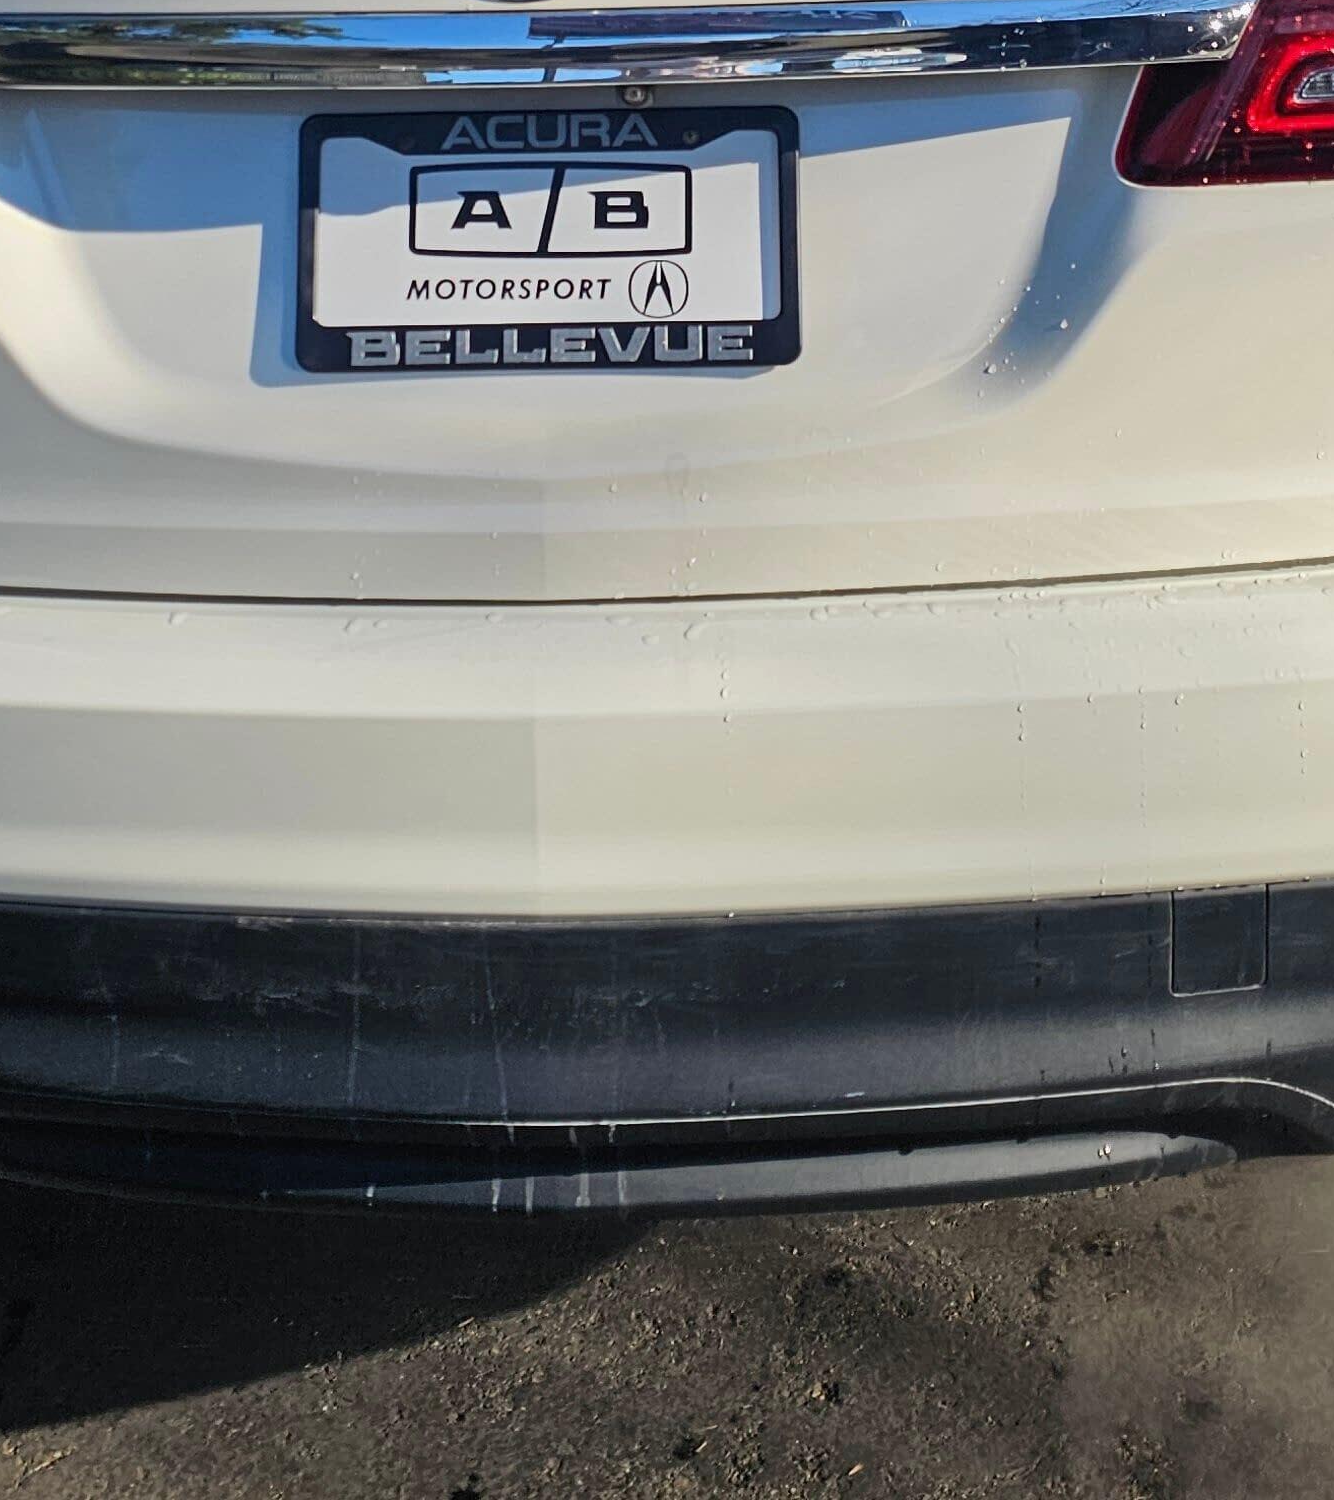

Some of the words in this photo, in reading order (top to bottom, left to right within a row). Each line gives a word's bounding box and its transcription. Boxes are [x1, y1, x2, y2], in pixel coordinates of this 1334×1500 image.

[441, 113, 659, 150] ACURA
[406, 278, 612, 301] MOTORSPORT
[347, 324, 754, 367] BELLEVUE
